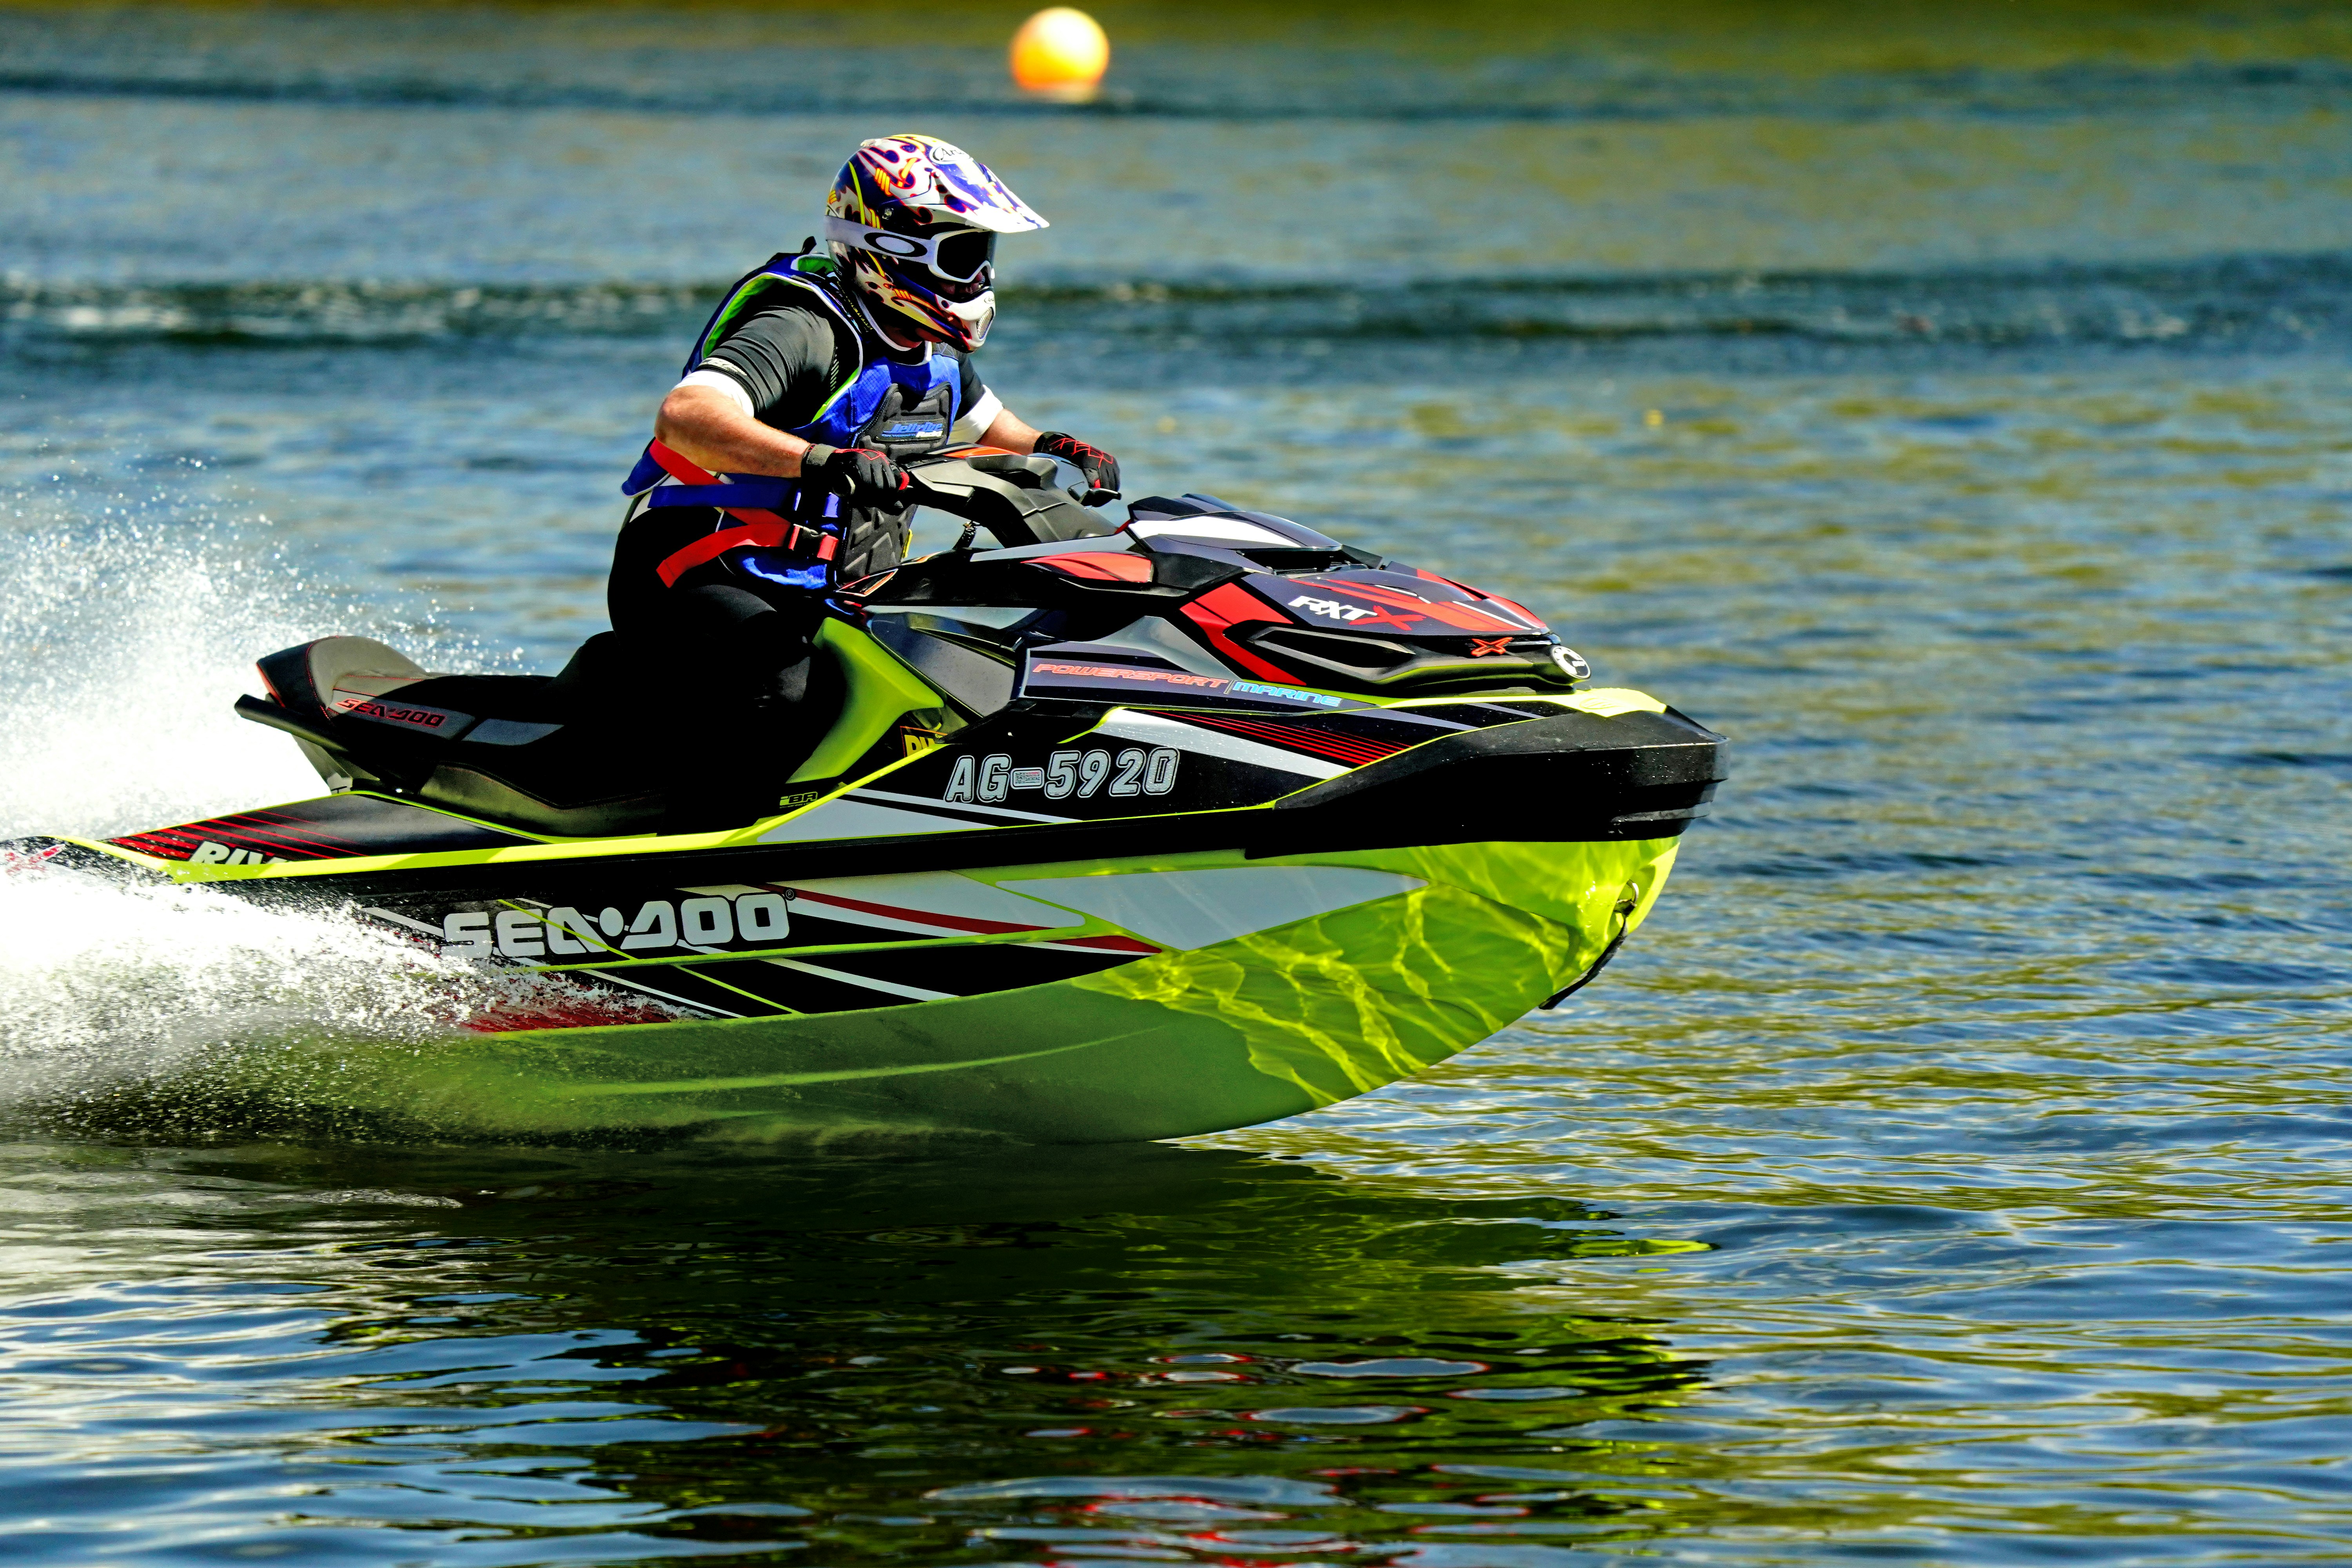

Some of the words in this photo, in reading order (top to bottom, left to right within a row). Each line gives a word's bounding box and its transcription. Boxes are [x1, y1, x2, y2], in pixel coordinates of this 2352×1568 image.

[1288, 595, 1378, 620] RXT
[1033, 664, 1229, 688] POWERSPORT
[1232, 681, 1342, 707] MARINE
